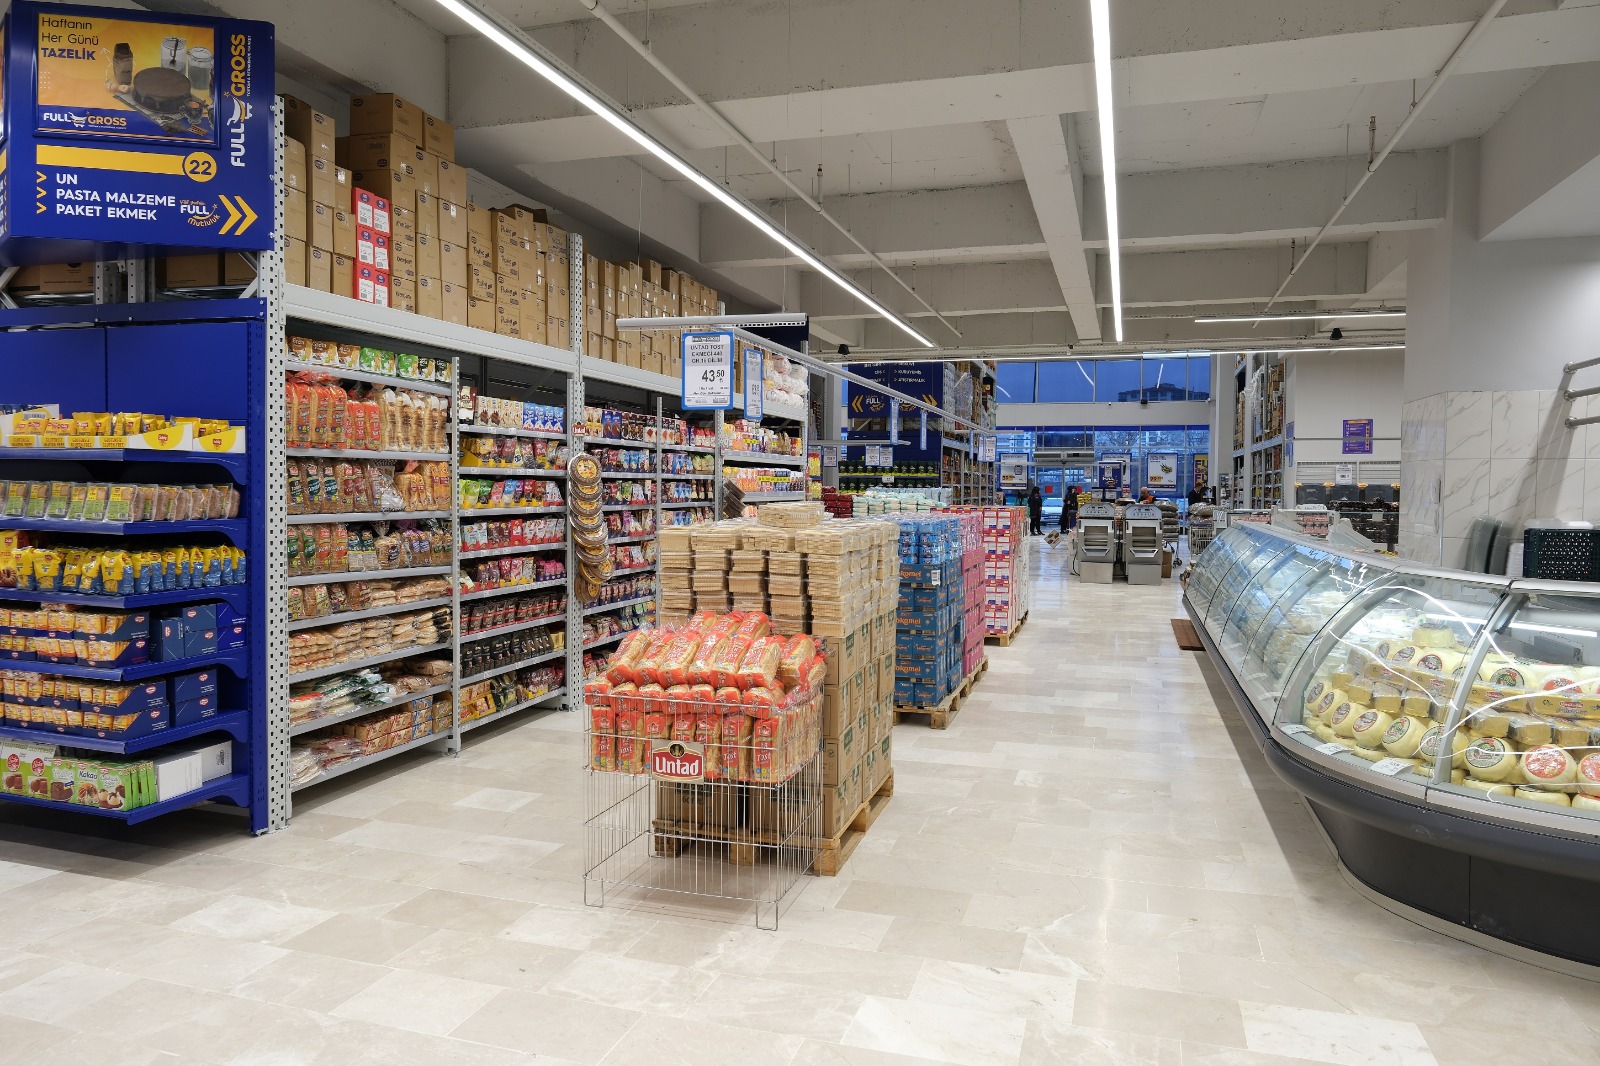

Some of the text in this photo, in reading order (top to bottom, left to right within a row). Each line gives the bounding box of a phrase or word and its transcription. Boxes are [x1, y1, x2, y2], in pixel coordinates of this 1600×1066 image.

[42, 16, 93, 30] Haftanın
[41, 32, 99, 46] Her Günü
[41, 47, 96, 61] TAZELİK
[230, 34, 246, 168] FULL GROSS
[43, 112, 72, 123] FULL
[87, 115, 127, 127] GROSS
[189, 159, 212, 176] 22
[56, 172, 78, 185] UN
[56, 188, 102, 202] PASTA
[105, 191, 176, 207] MALZEME
[56, 203, 158, 221] PAKET EKMEK
[180, 204, 210, 215] FULL
[655, 756, 699, 776] Untad
[79, 770, 98, 780] Kakao
